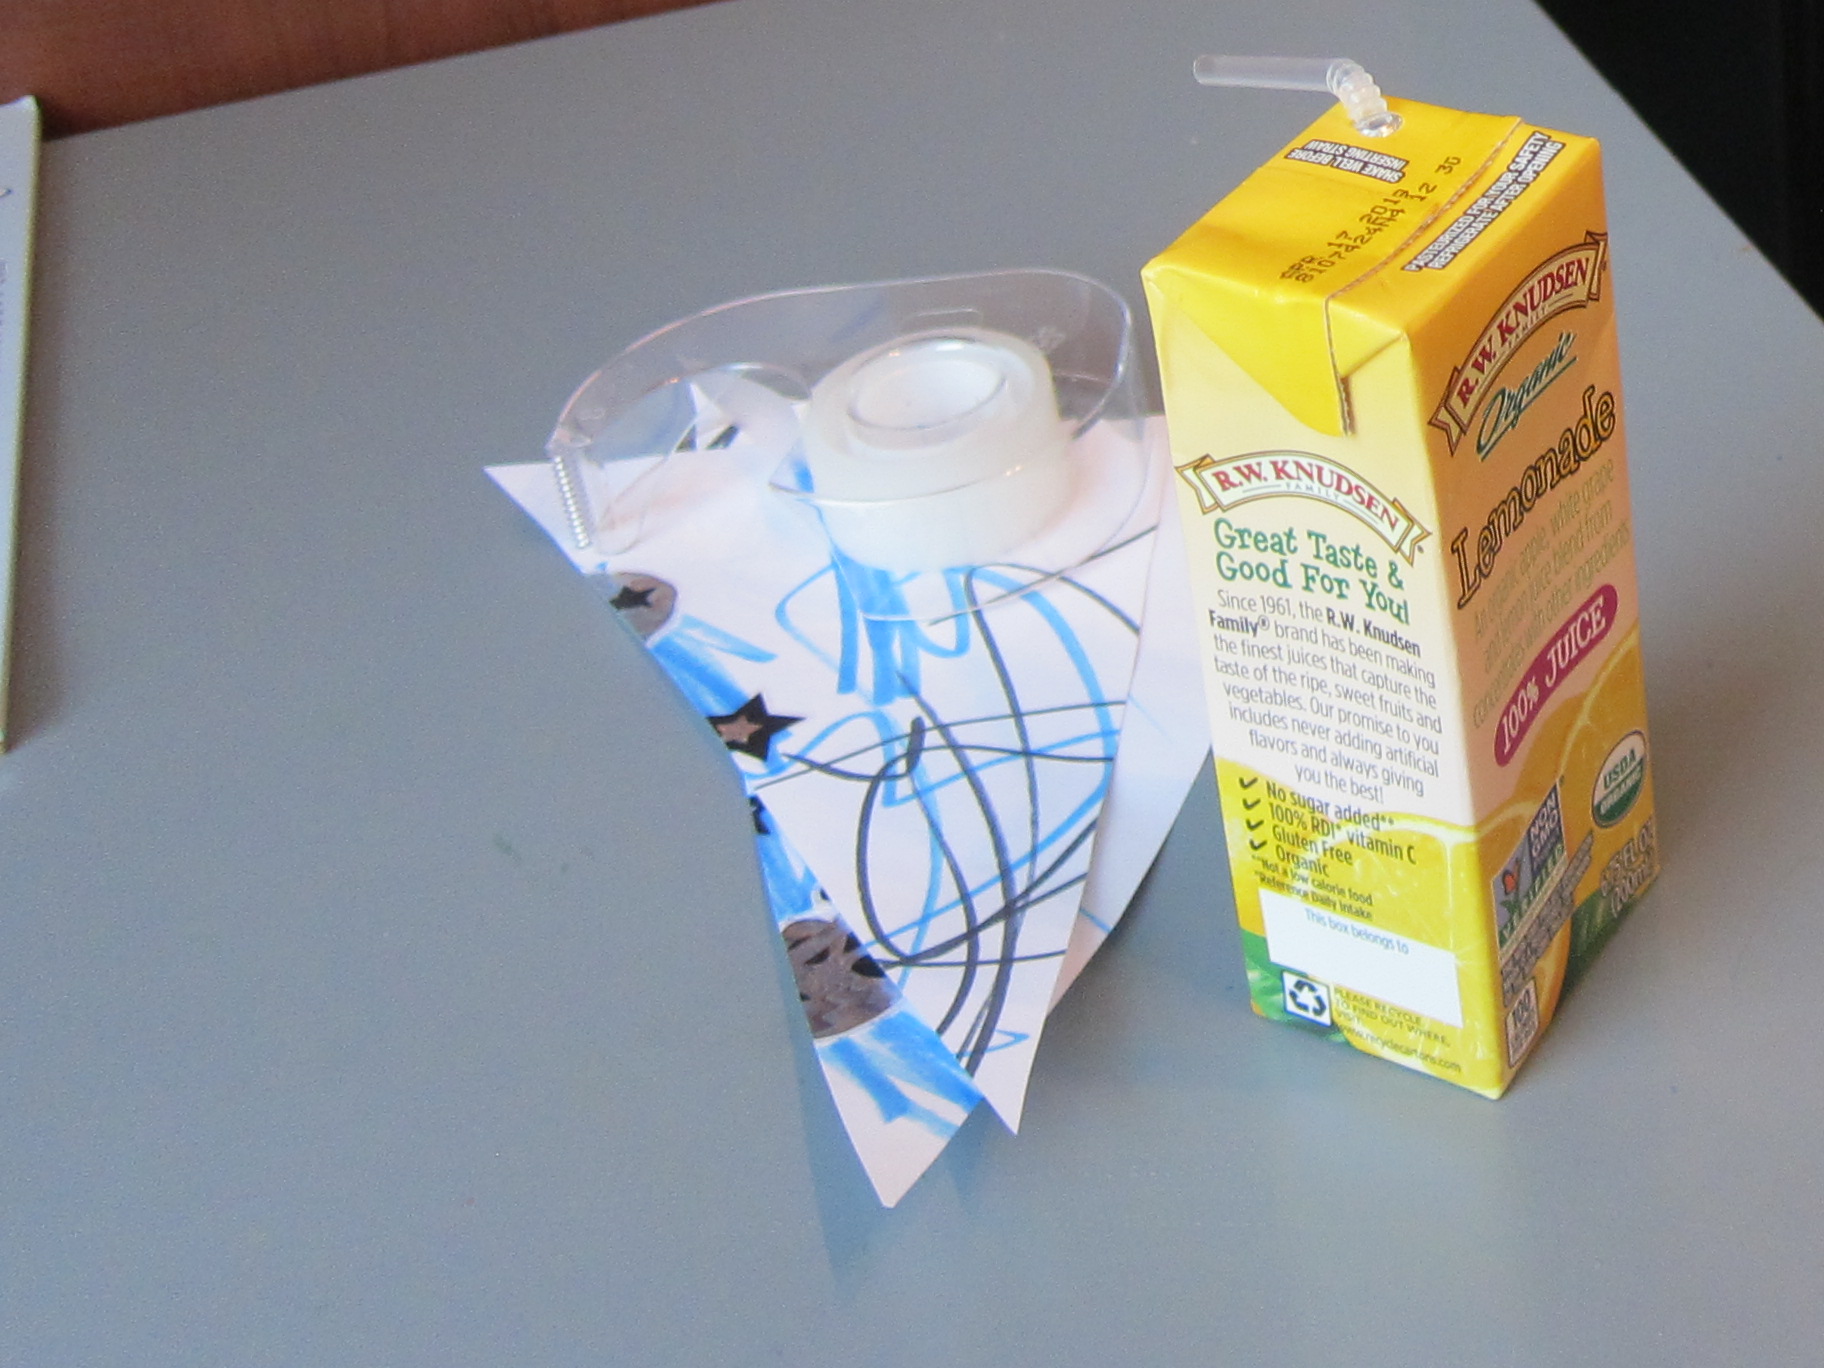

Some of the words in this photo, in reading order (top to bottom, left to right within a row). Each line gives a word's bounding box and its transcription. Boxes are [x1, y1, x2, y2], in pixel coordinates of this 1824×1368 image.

[1287, 149, 1334, 165] BEFORE
[1303, 140, 1348, 155] STRAW
[1331, 156, 1365, 173] WELL
[1344, 147, 1407, 171] INSERTING
[1361, 163, 1403, 183] SHAKE
[1404, 215, 1475, 271] PASTEURIZED
[1466, 197, 1492, 215] FOR
[1487, 171, 1519, 198] YOUR
[1509, 132, 1550, 171] SAFETY
[1427, 211, 1499, 269] REFRIGERATE
[1489, 183, 1526, 212] AFTER
[1517, 141, 1563, 182] OPENING
[1497, 257, 1590, 345] KNUDSEN
[1476, 330, 1577, 454] Organic
[1269, 459, 1400, 532] KNUDSEN
[1285, 483, 1341, 500] FAMILY
[1451, 386, 1617, 610] Lemonade
[1214, 517, 1298, 556] Great
[1307, 530, 1378, 578] Taste
[1388, 560, 1405, 590] &
[1216, 551, 1293, 589] Good
[1300, 561, 1350, 599] For
[1359, 578, 1410, 625] You!
[1217, 589, 1257, 612] Since
[1260, 594, 1296, 619] 1961,
[1299, 602, 1323, 623] the
[1326, 607, 1361, 634] R.W.
[1363, 617, 1421, 658] Knudsen
[1214, 634, 1237, 654] the
[1241, 638, 1283, 661] finest
[1287, 647, 1328, 670] juices
[1330, 655, 1358, 680] that
[1361, 669, 1411, 698] capture
[1414, 686, 1437, 709] the
[1274, 621, 1319, 644] brand
[1322, 629, 1346, 651] has
[1349, 635, 1382, 665] been
[1386, 652, 1436, 688] making
[1503, 675, 1539, 755] 100%
[1545, 595, 1606, 688] JUICE
[1214, 656, 1249, 678] taste
[1253, 664, 1270, 685] of
[1272, 666, 1297, 686] the
[1300, 673, 1332, 698] ripe,
[1334, 683, 1376, 709] sweet
[1378, 695, 1414, 723] fruits
[1416, 711, 1442, 734] and
[1223, 682, 1306, 712] vegetables.
[1310, 695, 1334, 719] Our
[1338, 707, 1393, 736] promise
[1396, 727, 1410, 744] to
[1413, 733, 1439, 756] you
[1229, 702, 1288, 730] includes
[1291, 718, 1330, 739] never
[1334, 729, 1382, 759] adding
[1385, 746, 1439, 777] artificial
[1249, 729, 1298, 756] flavors
[1301, 743, 1327, 763] and
[1330, 751, 1378, 780] always
[1382, 768, 1424, 797] giving
[1294, 764, 1321, 783] you
[1324, 770, 1347, 791] the
[1351, 780, 1384, 804] best!
[1603, 748, 1638, 789] USDA
[1265, 781, 1286, 802] No
[1289, 792, 1330, 819] sugar
[1529, 792, 1557, 837] NON
[1269, 802, 1307, 830] 100%
[1347, 829, 1403, 859] vitamin
[1407, 845, 1416, 864] C
[1272, 825, 1319, 853] Gluten
[1322, 841, 1353, 866] Free
[1531, 807, 1558, 859] GMO
[1275, 845, 1329, 878] Organic
[1291, 866, 1309, 884] low
[1311, 874, 1347, 896] calorie
[1348, 887, 1373, 906] food
[1311, 889, 1337, 912] Daily
[1339, 900, 1373, 920] Intake
[1304, 908, 1327, 928] This
[1329, 919, 1350, 935] box
[1350, 922, 1395, 950] belongs
[1397, 937, 1410, 955] to
[1351, 1004, 1379, 1020] FIND
[1381, 1013, 1406, 1029] OUT
[1511, 987, 1531, 1023] 100
